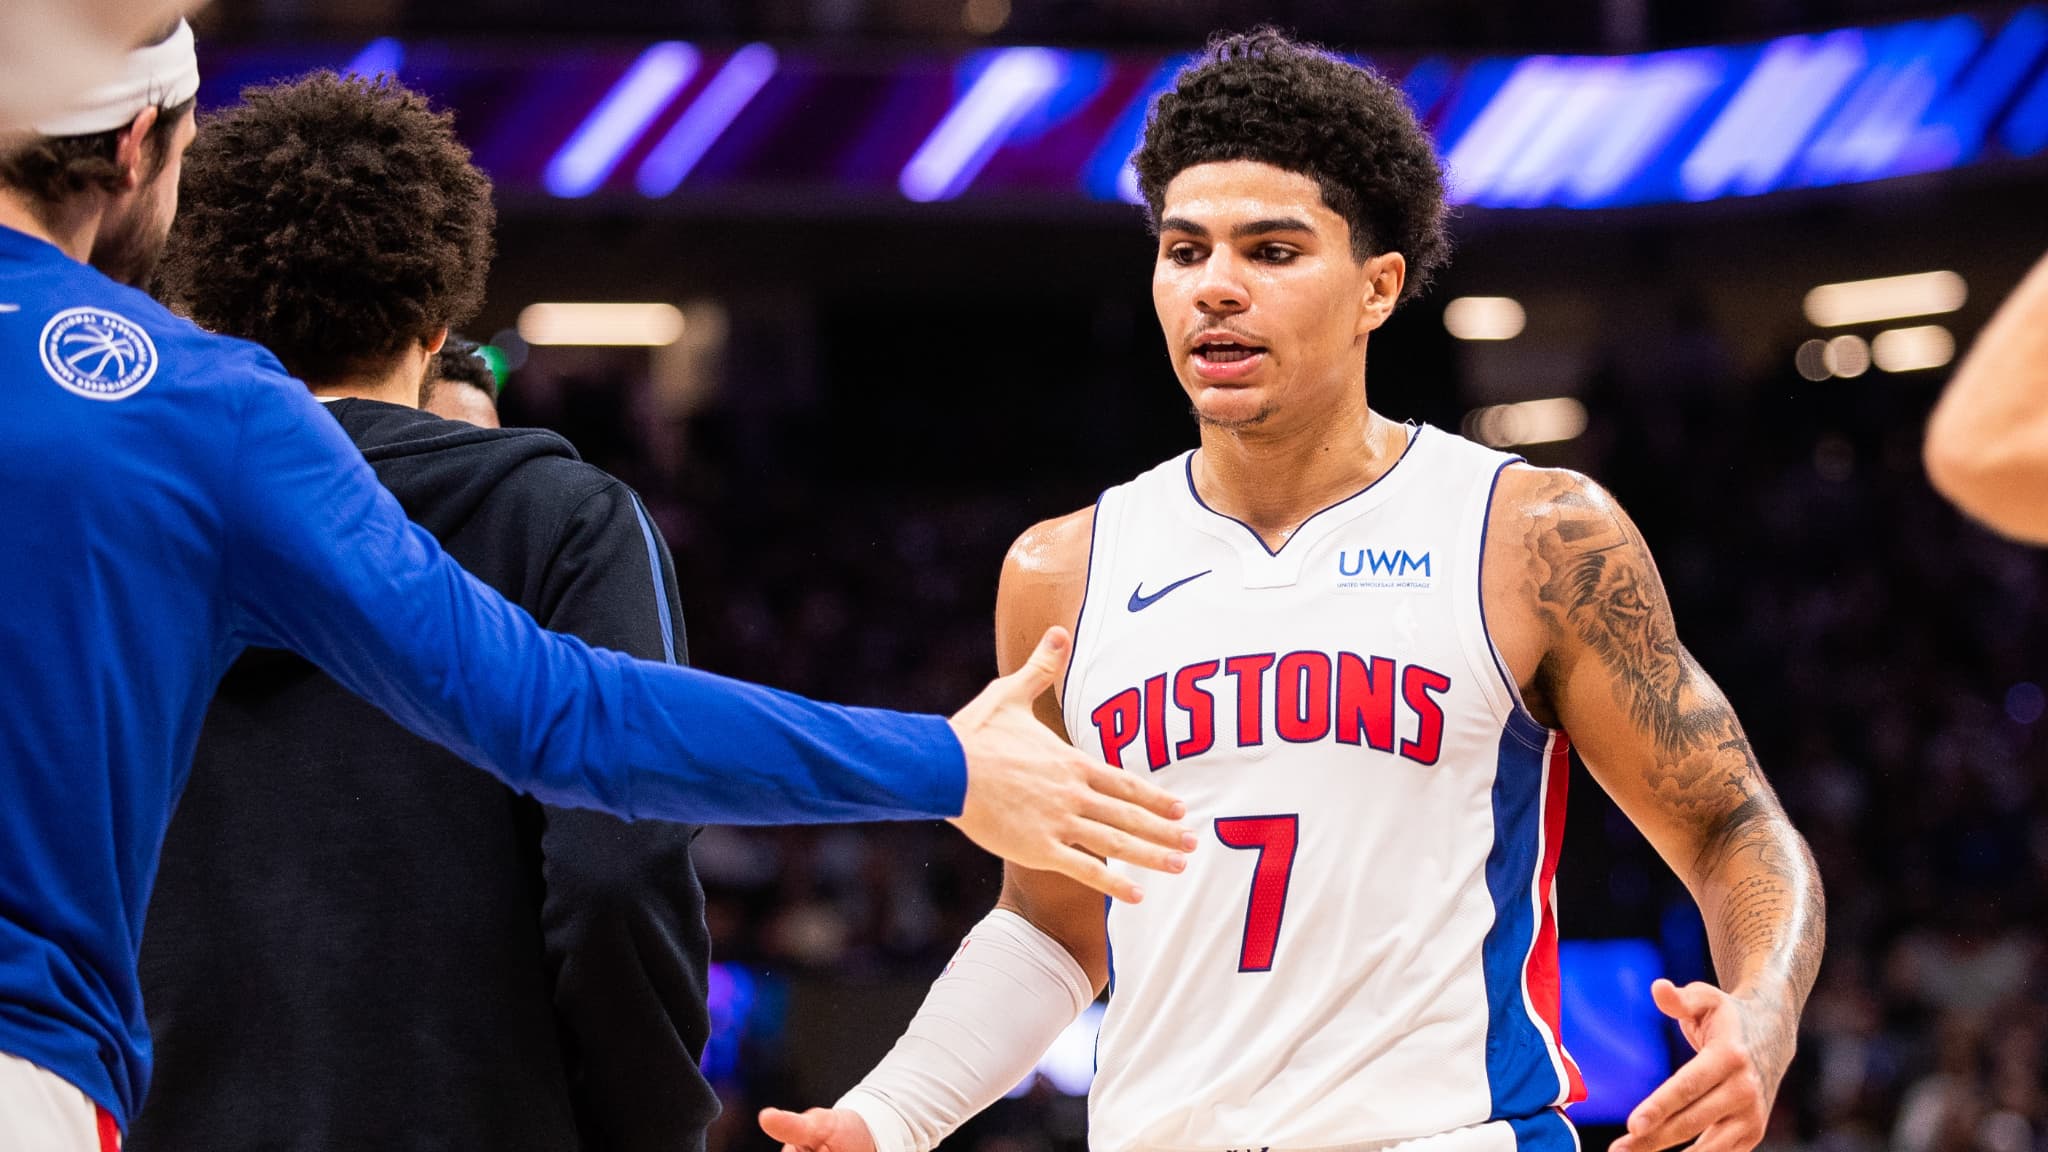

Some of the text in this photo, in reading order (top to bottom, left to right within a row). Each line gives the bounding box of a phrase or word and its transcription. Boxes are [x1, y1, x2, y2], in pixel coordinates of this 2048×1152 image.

[1339, 549, 1431, 577] UWM
[1091, 650, 1451, 773] PISTONS
[1214, 813, 1299, 973] 7
